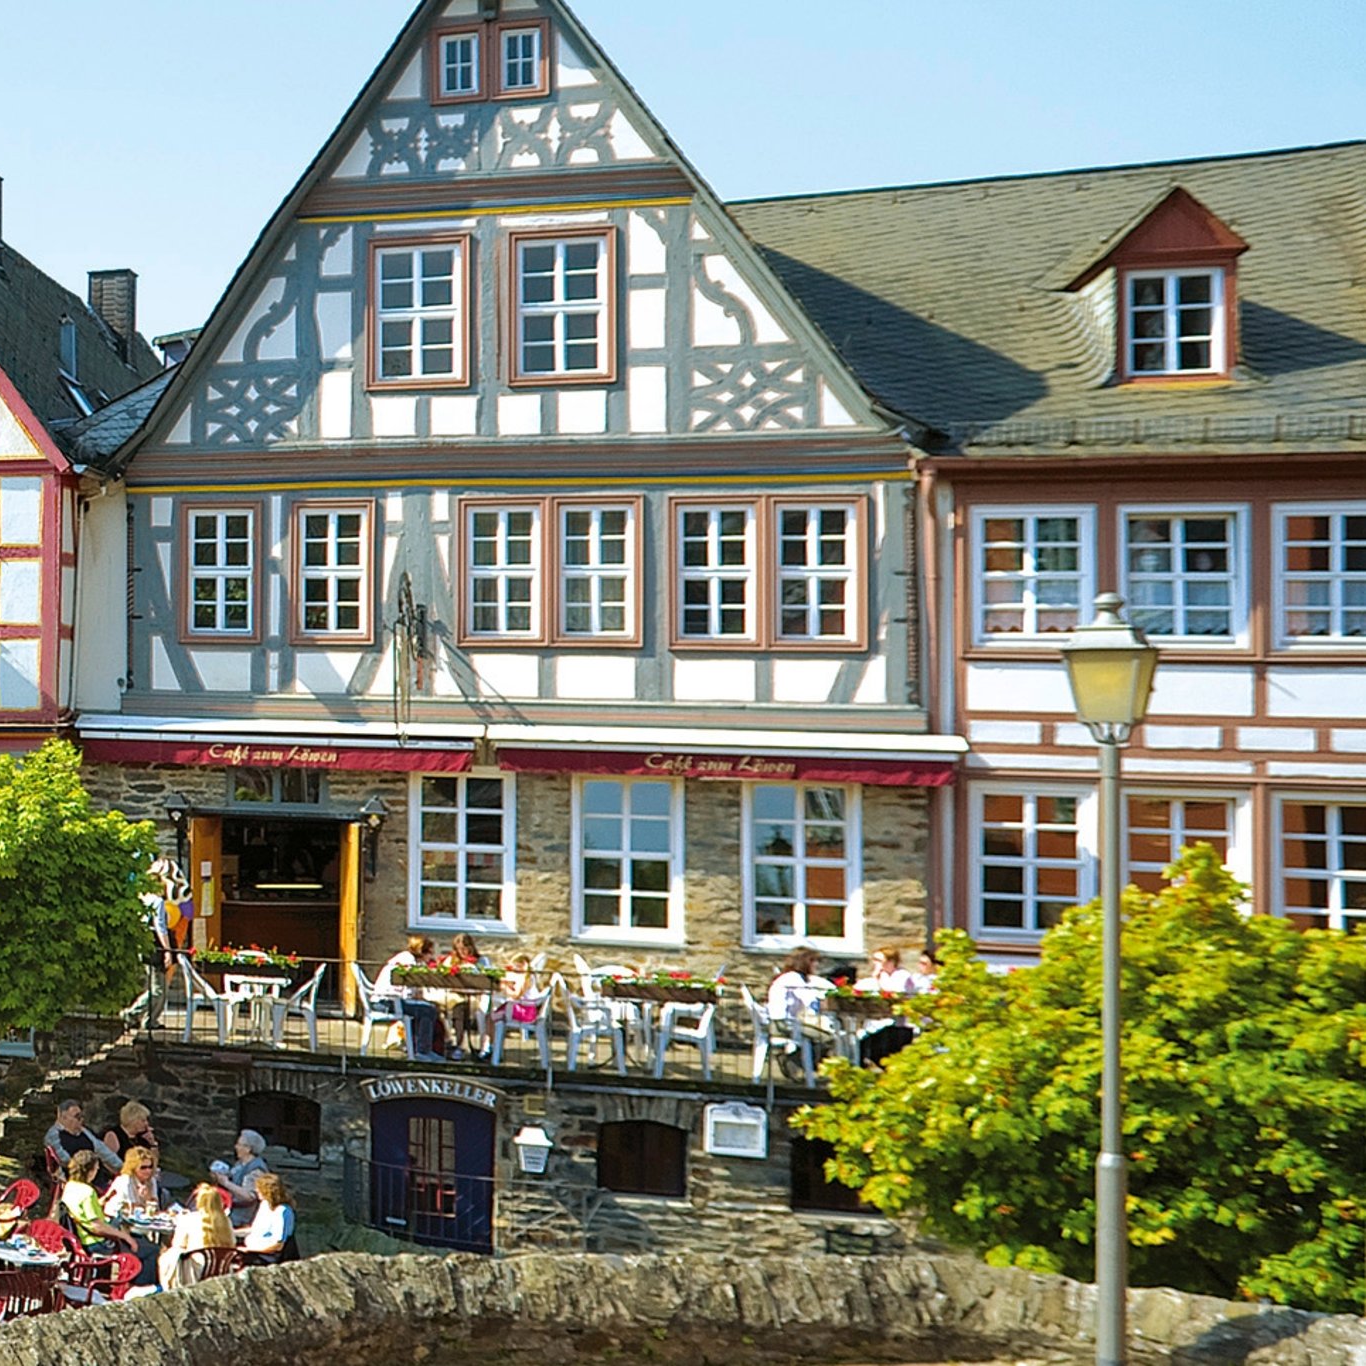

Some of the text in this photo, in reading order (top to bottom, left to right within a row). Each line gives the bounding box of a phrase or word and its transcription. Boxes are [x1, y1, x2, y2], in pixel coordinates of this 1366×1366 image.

[208, 743, 338, 766] Café zum Löwen
[644, 753, 797, 775] Café zum Löwen
[368, 1078, 497, 1108] LÖWENKELLER
